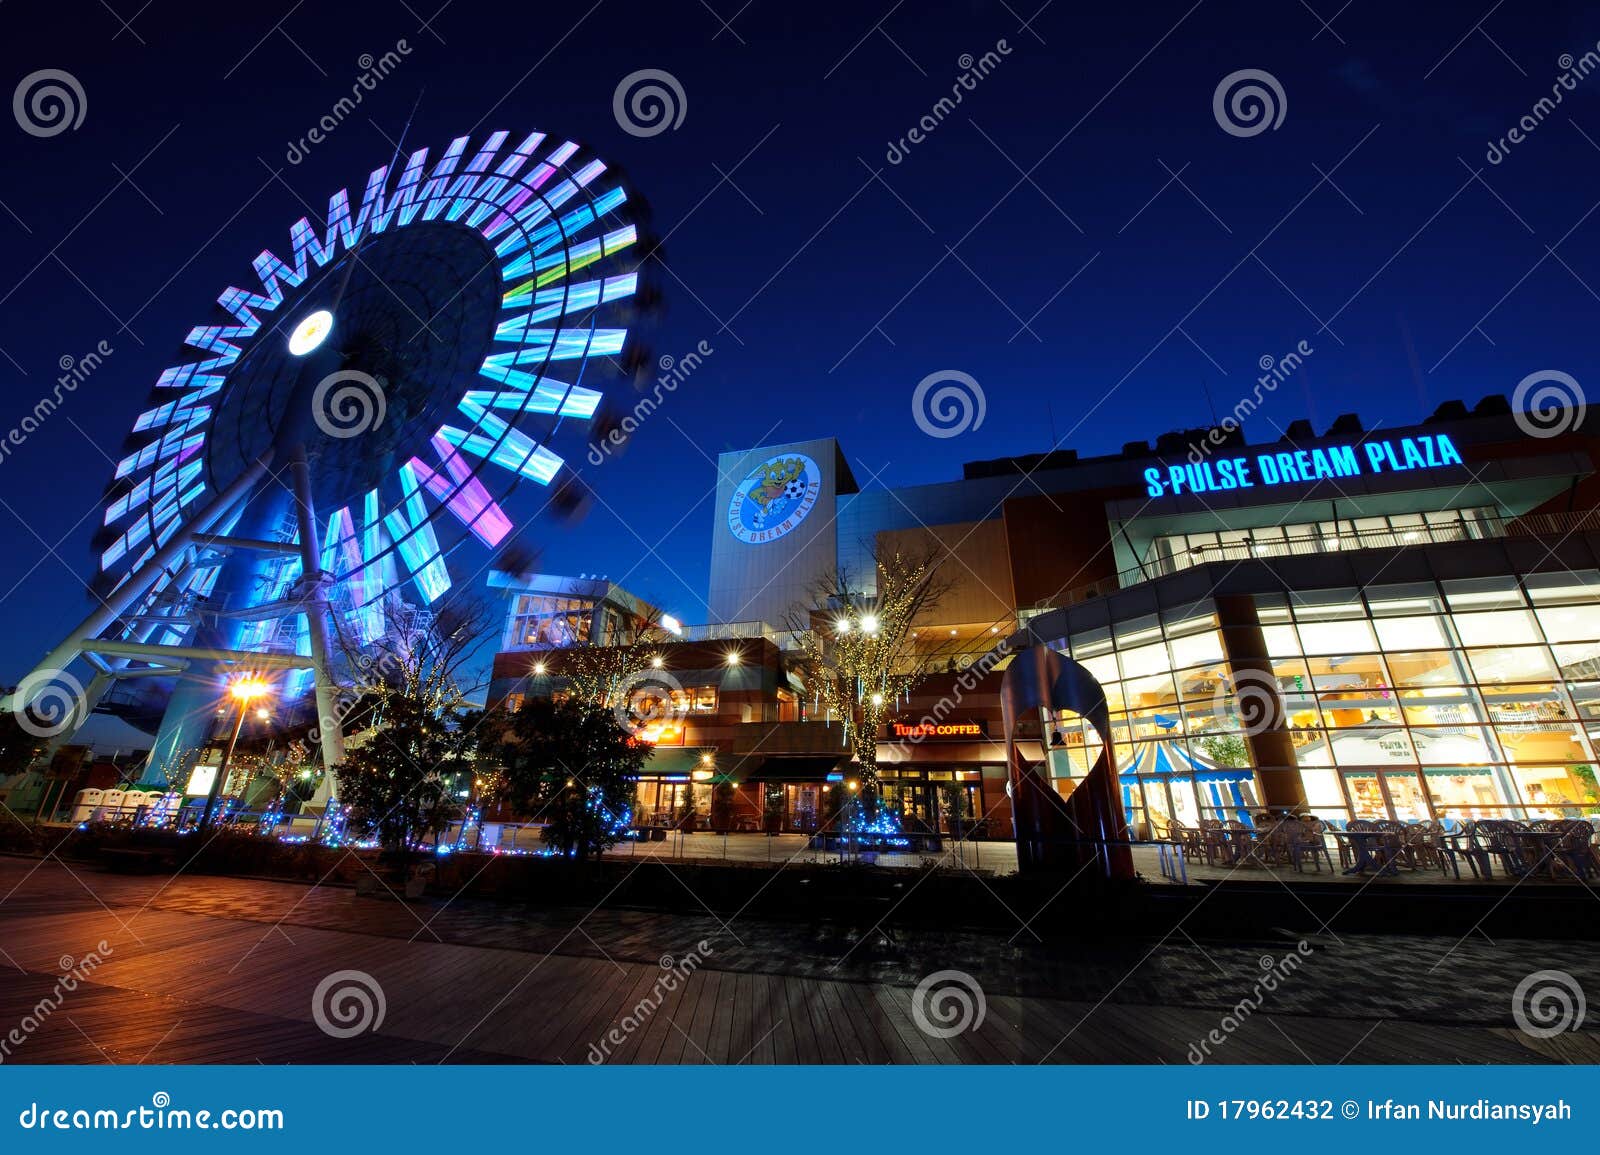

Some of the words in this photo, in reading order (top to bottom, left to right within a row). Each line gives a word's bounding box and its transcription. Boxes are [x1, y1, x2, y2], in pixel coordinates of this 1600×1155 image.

[1144, 457, 1254, 498] S-PULSE
[1257, 445, 1361, 486] DREAM
[1364, 434, 1462, 474] PLAZA
[750, 519, 794, 542] DREAM
[795, 481, 819, 519] PLAZA
[937, 725, 980, 735] COFFEE
